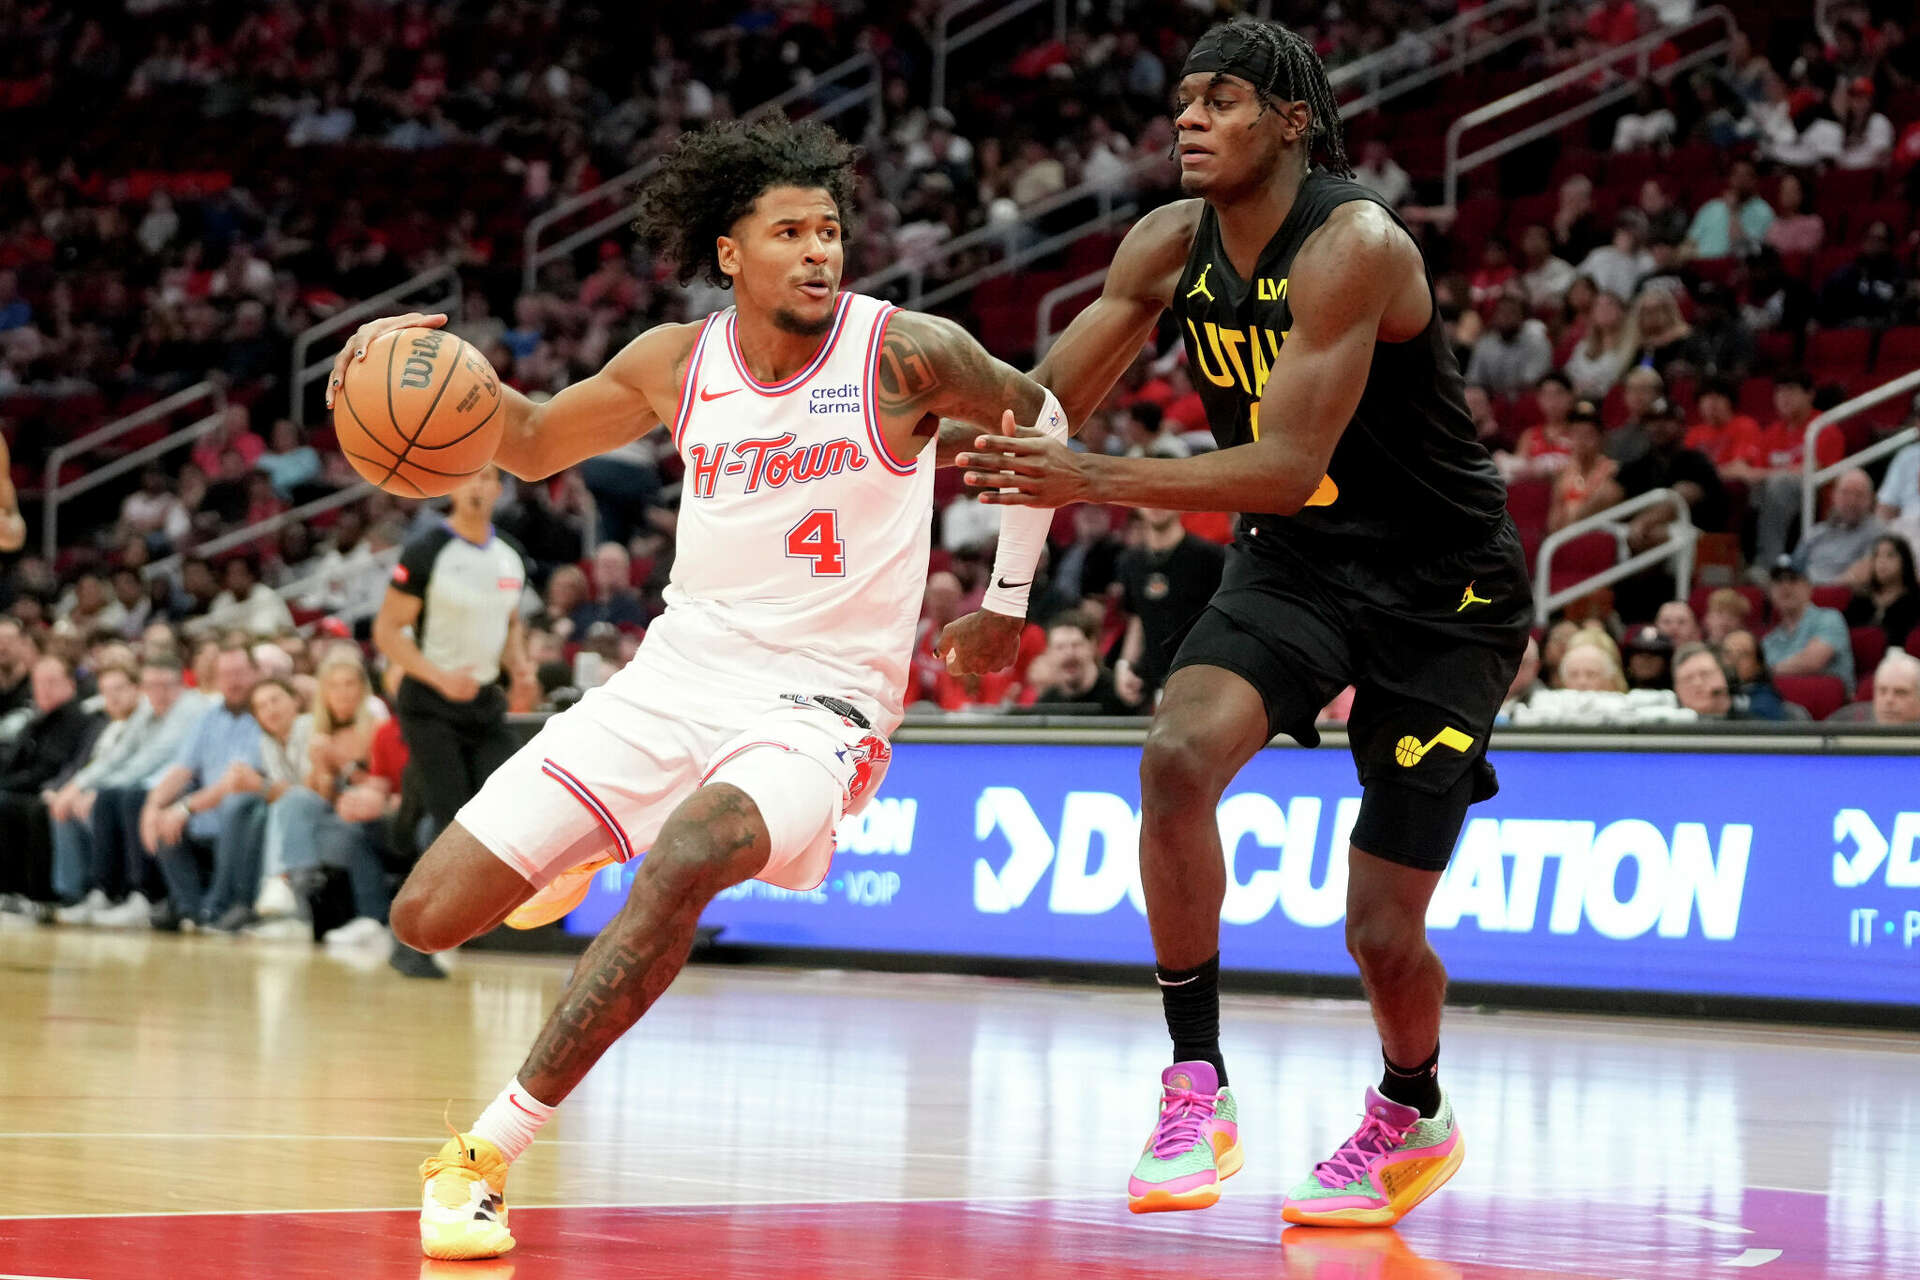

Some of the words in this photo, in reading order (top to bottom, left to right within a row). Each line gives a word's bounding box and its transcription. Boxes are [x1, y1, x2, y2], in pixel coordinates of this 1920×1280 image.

[809, 400, 860, 415] karma
[811, 384, 860, 399] credit
[689, 432, 868, 498] H-Town
[785, 509, 846, 577] 4
[1049, 791, 1754, 941] DCUATION
[845, 870, 901, 906] VOIP
[1851, 907, 1879, 947] IT
